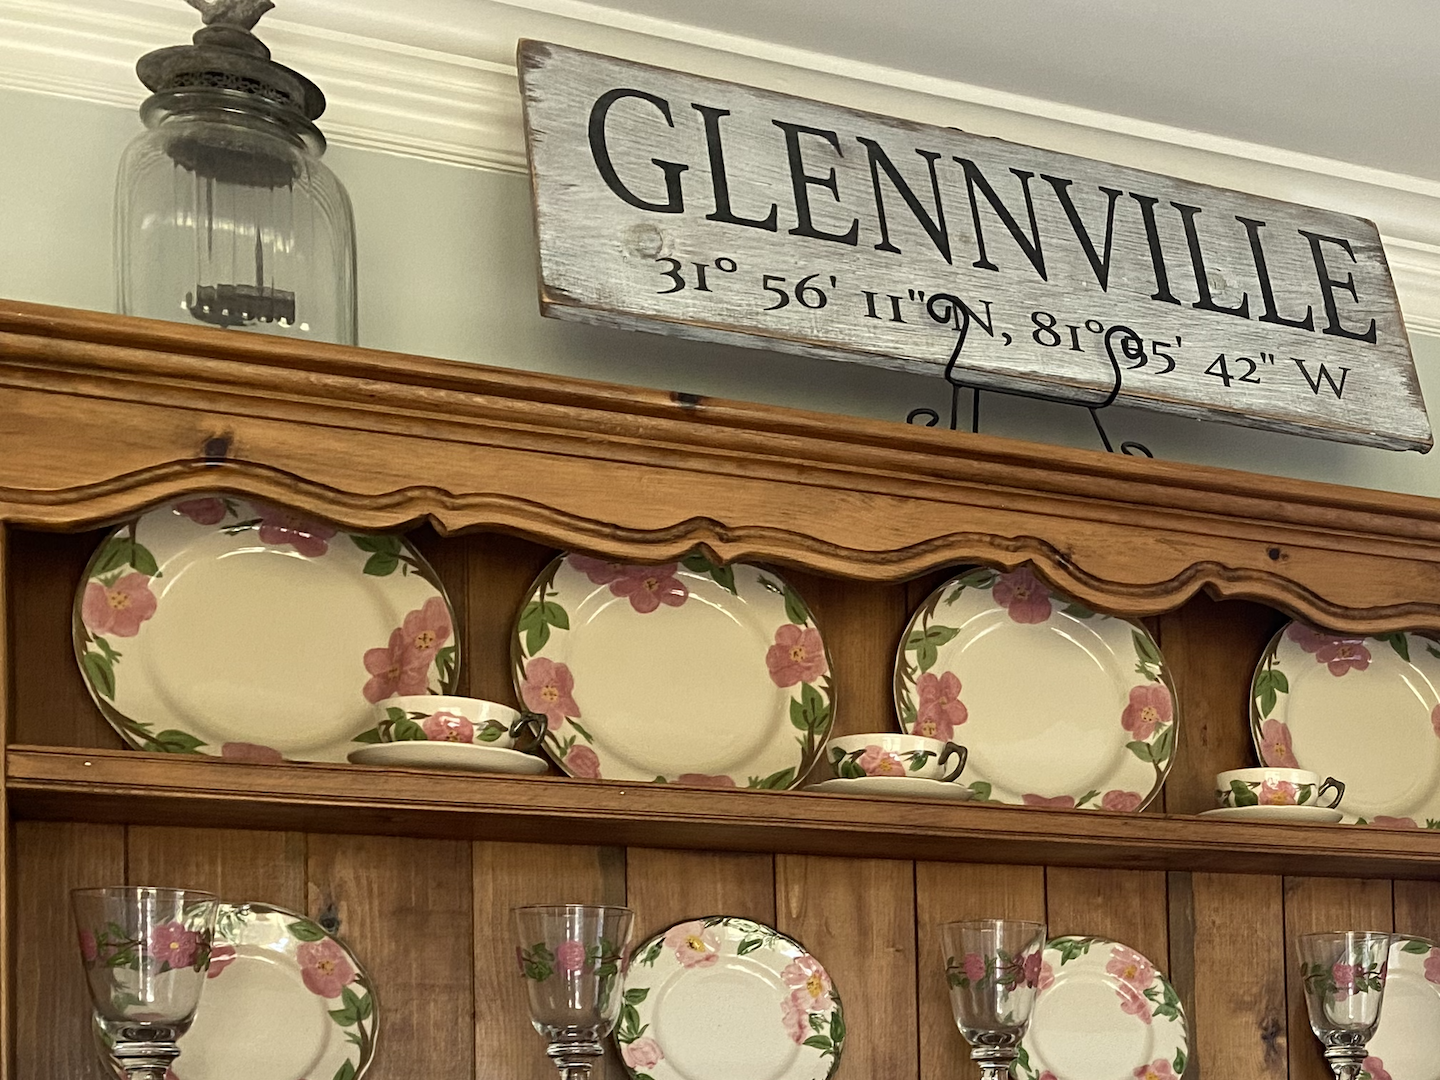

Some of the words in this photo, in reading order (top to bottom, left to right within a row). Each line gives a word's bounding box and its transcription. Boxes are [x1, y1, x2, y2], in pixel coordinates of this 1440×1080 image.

[588, 87, 1377, 345] GLENNVILLE
[655, 257, 738, 294] 31°
[762, 273, 837, 311] 56'
[1031, 311, 1105, 353] 81°
[1204, 352, 1275, 387] 42"
[1291, 357, 1352, 400] W
